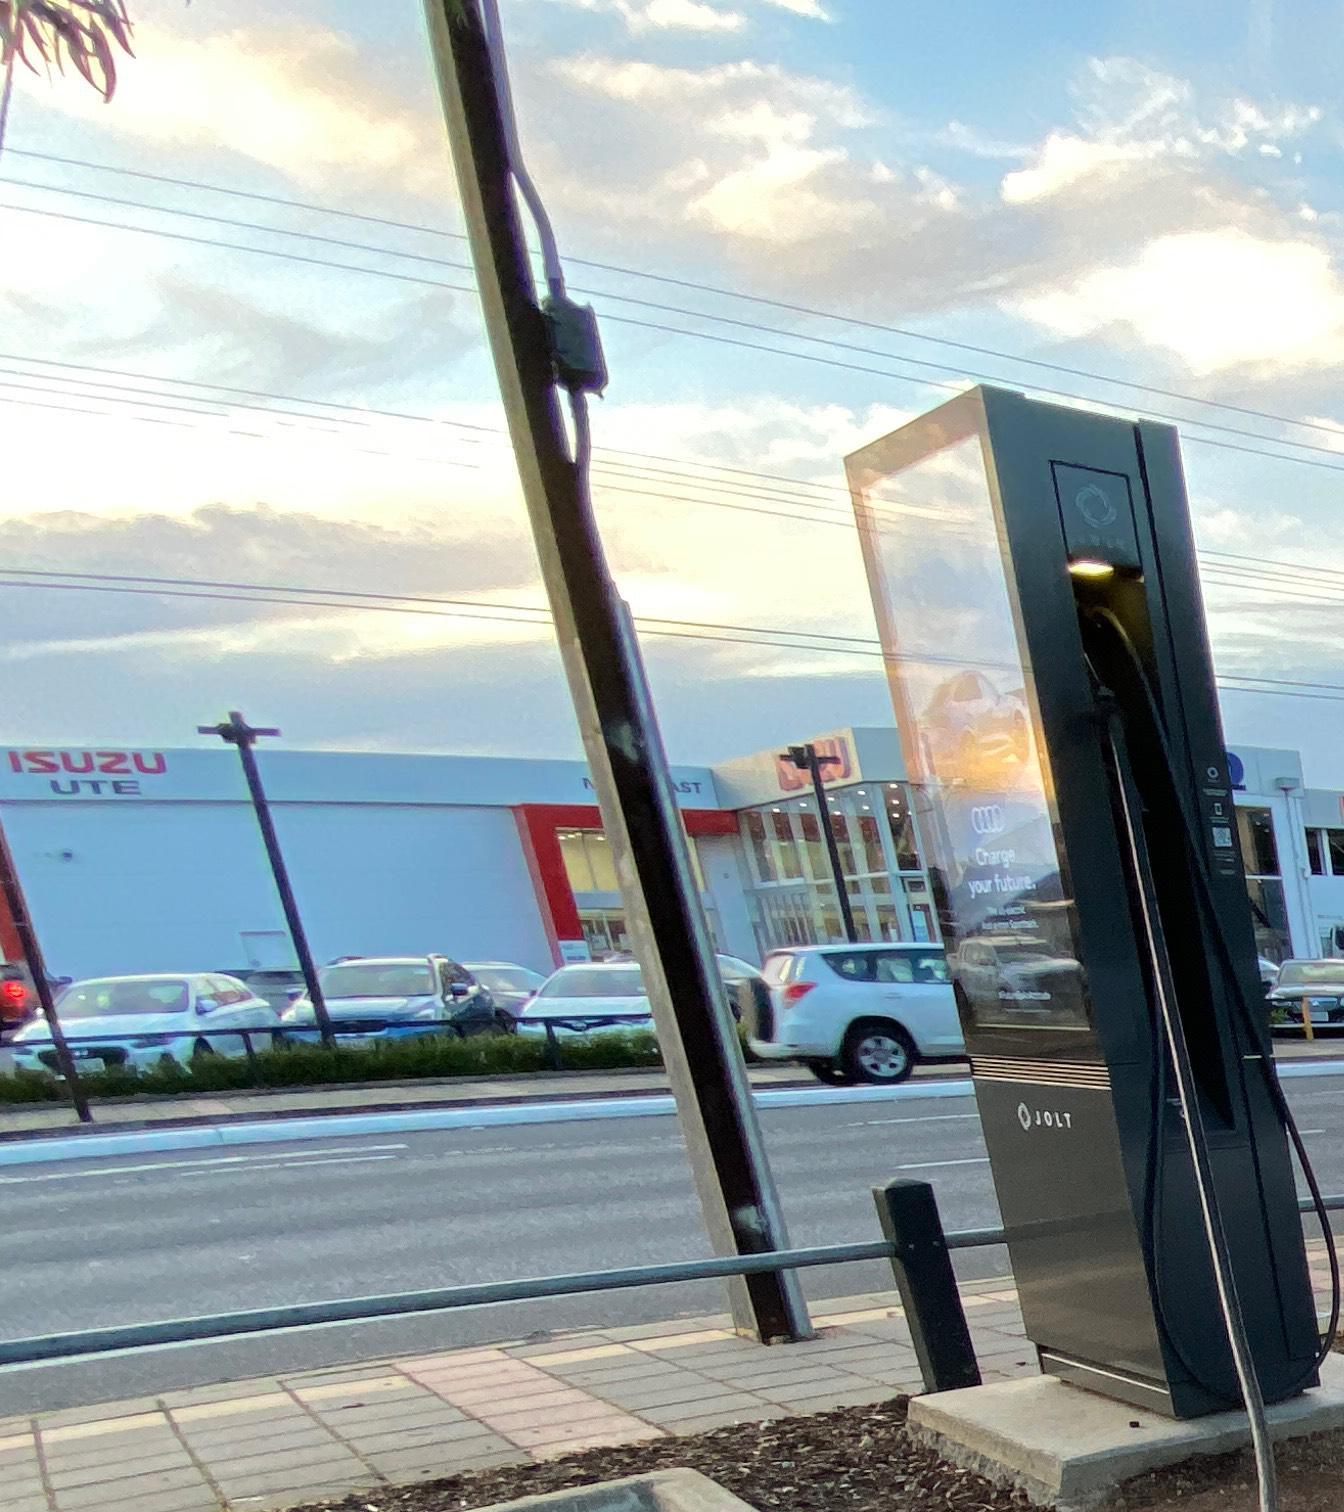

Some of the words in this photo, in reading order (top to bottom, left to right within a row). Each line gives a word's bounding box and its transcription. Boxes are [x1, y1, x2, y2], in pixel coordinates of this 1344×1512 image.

[8, 751, 167, 774] ISUZU
[50, 779, 141, 795] UTE
[975, 847, 1016, 868] Charge
[968, 879, 992, 899] your
[994, 873, 1037, 891] future.
[1036, 1110, 1071, 1128] JOLT
